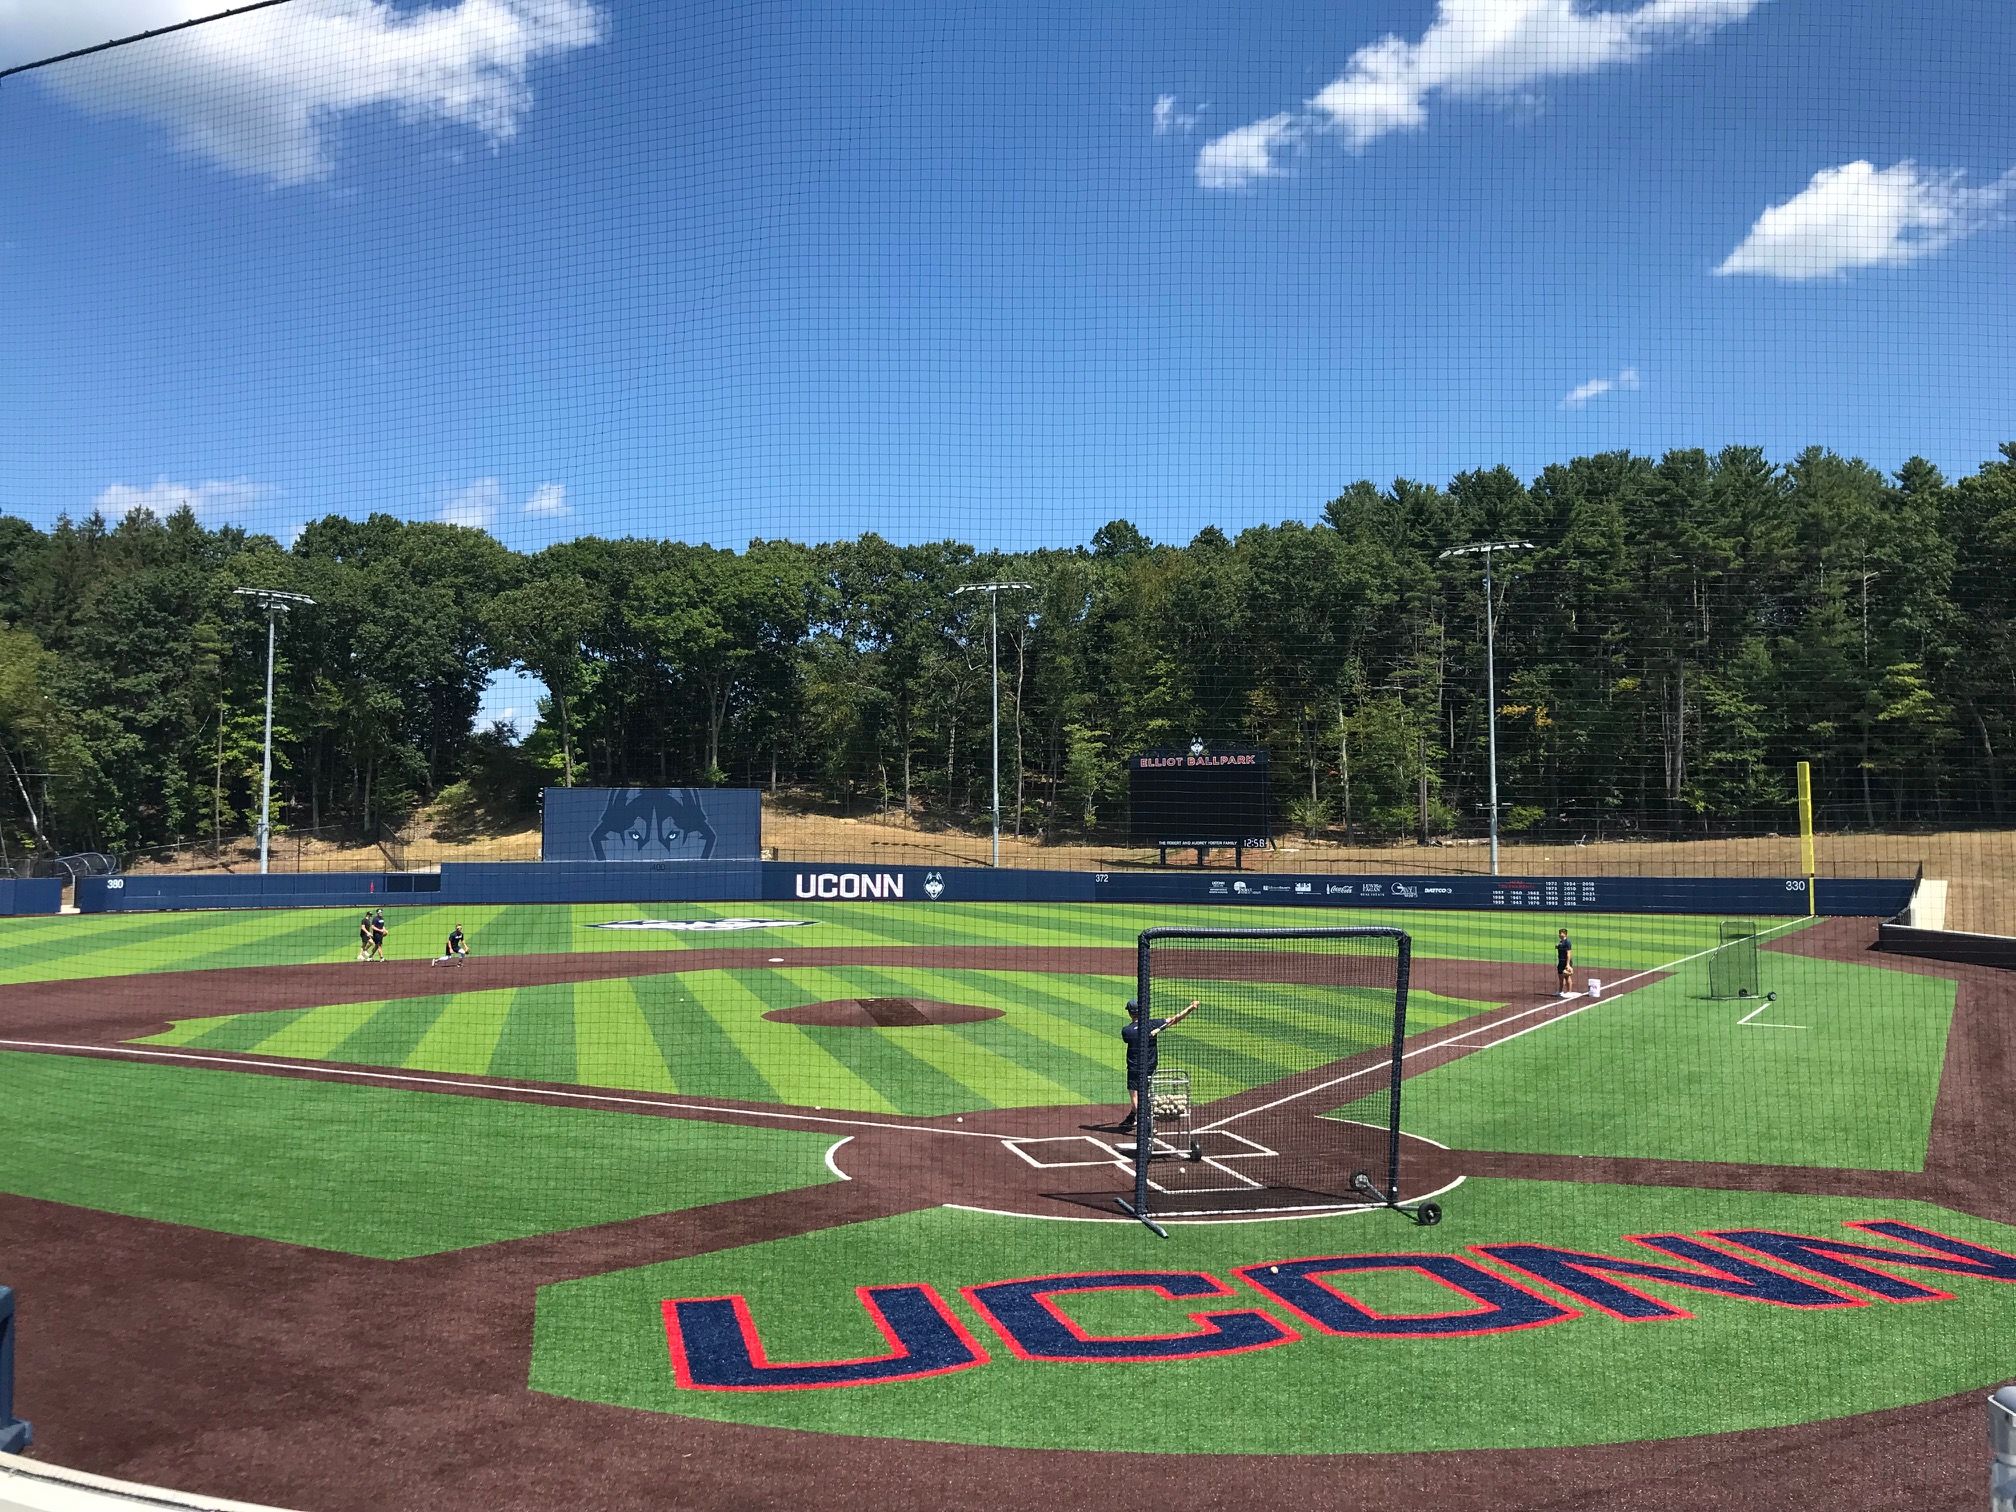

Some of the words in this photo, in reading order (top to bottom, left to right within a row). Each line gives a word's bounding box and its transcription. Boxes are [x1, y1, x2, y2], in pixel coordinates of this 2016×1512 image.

[1140, 757, 1183, 768] ELLIOT
[1188, 755, 1256, 766] BALLPARK
[1244, 838, 1264, 848] 12:58
[1096, 874, 1108, 882] 372
[107, 879, 124, 889] 380
[796, 874, 904, 898] UCONN
[1786, 880, 1805, 891] 330
[1330, 885, 1354, 894] Coca-Cola
[661, 1218, 2016, 1392] UCONN
